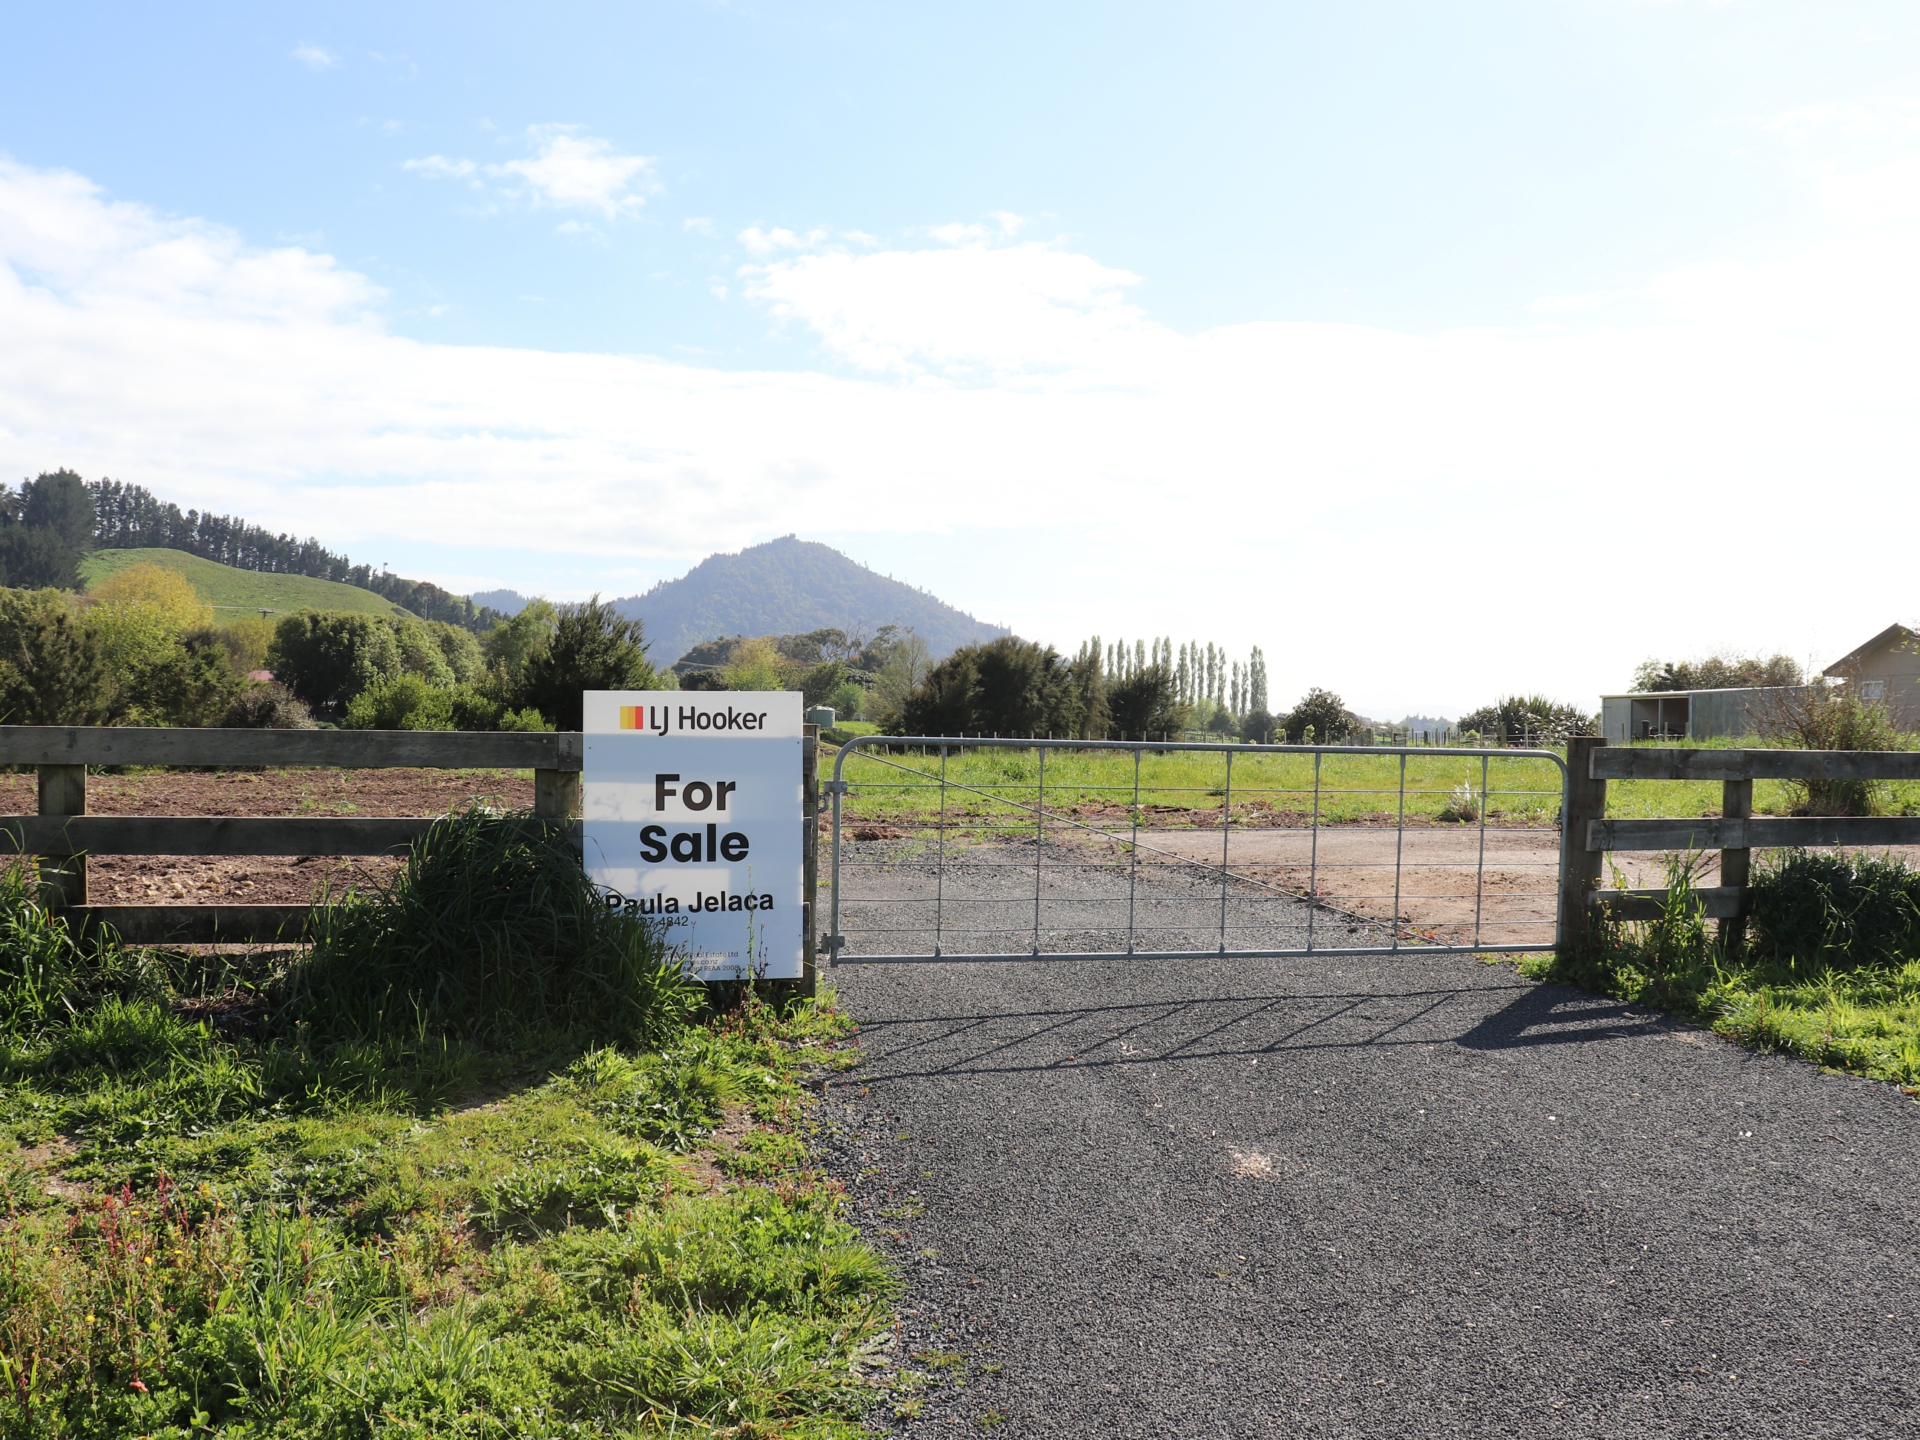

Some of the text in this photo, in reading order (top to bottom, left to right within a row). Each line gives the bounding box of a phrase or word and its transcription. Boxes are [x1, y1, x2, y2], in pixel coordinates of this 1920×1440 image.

[650, 706, 767, 736] LJ Hooker
[655, 773, 736, 812] For
[639, 823, 750, 863] Sale
[605, 891, 774, 915] Paula Jelaca
[659, 916, 689, 927] 4842
